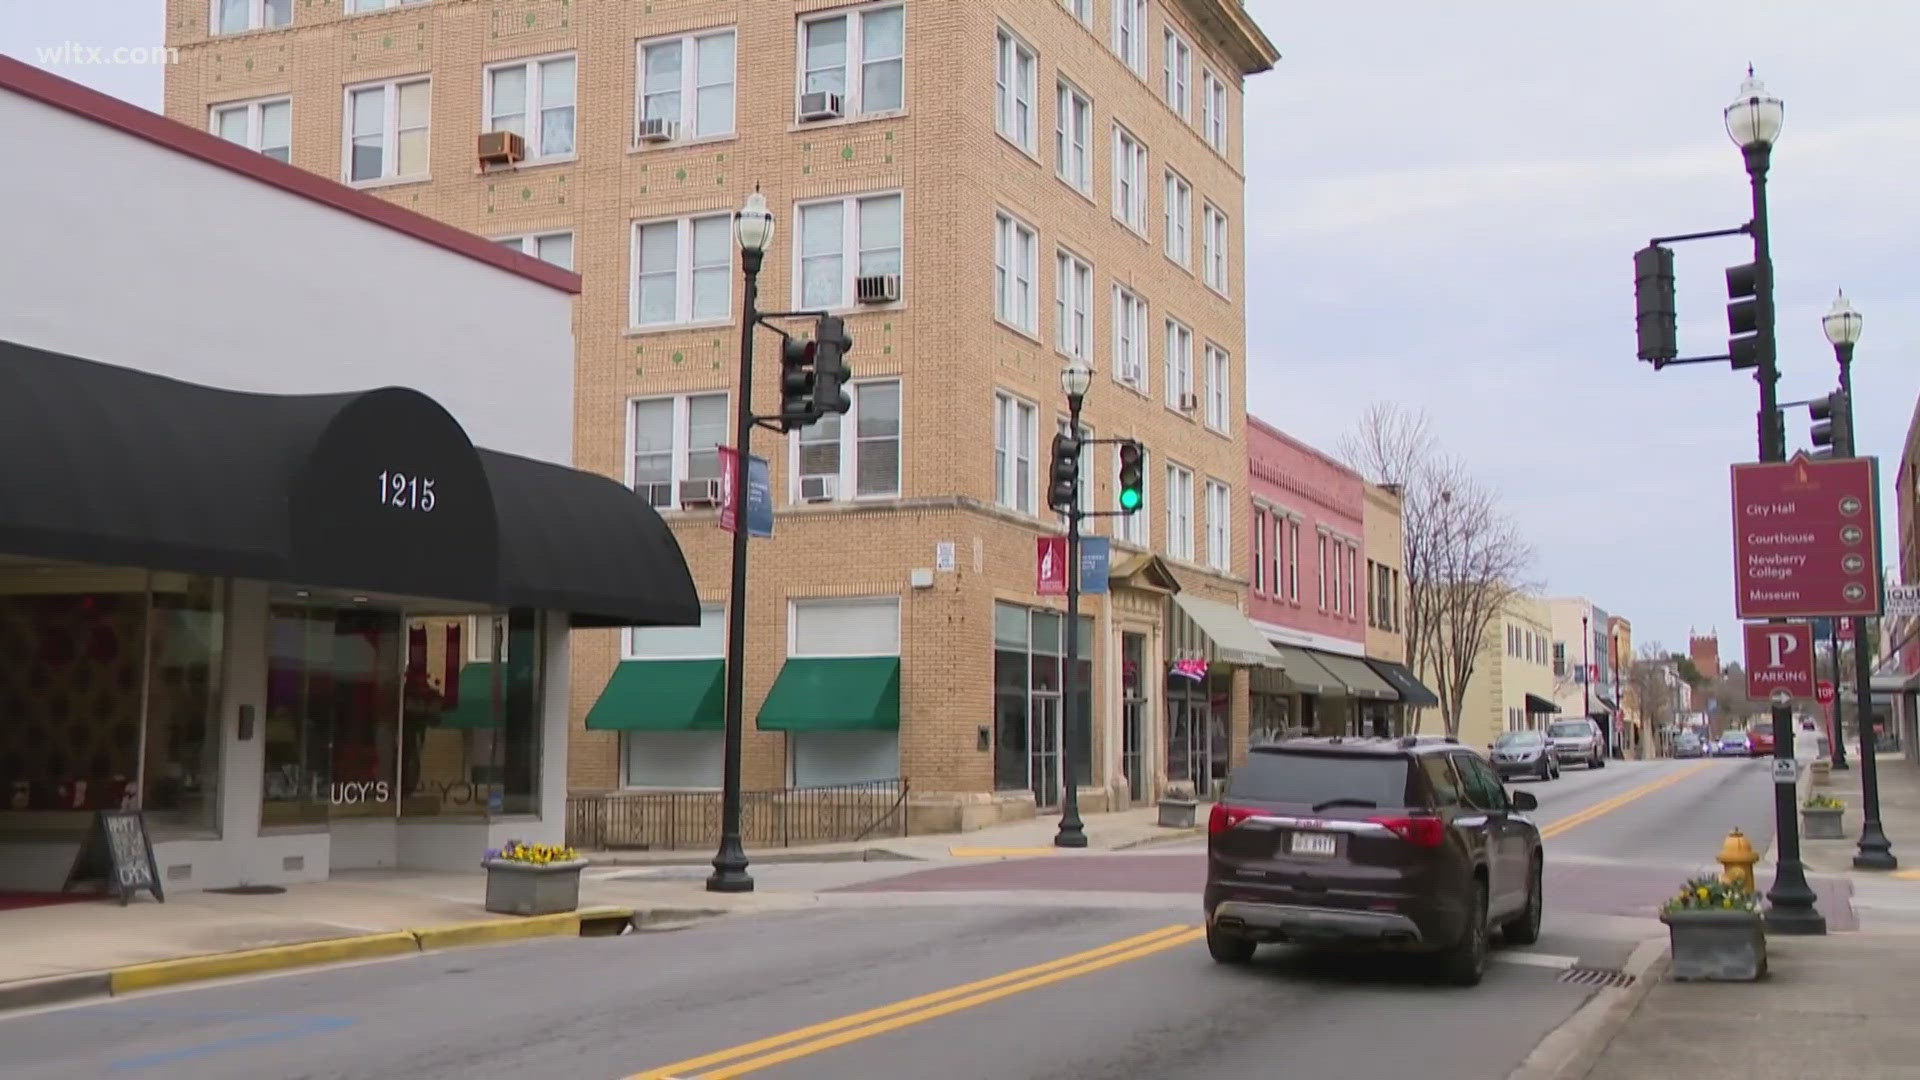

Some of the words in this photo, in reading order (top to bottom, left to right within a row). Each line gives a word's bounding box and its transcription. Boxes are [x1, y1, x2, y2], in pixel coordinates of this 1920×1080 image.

[378, 469, 436, 512] 1215
[1746, 504, 1769, 517] City
[1772, 502, 1796, 514] Hall
[1747, 531, 1816, 545] Courthouse
[1748, 553, 1807, 568] Newberry
[1748, 566, 1793, 580] College
[1749, 589, 1800, 602] Museum
[1767, 632, 1798, 668] P
[1753, 671, 1807, 682] PARKING
